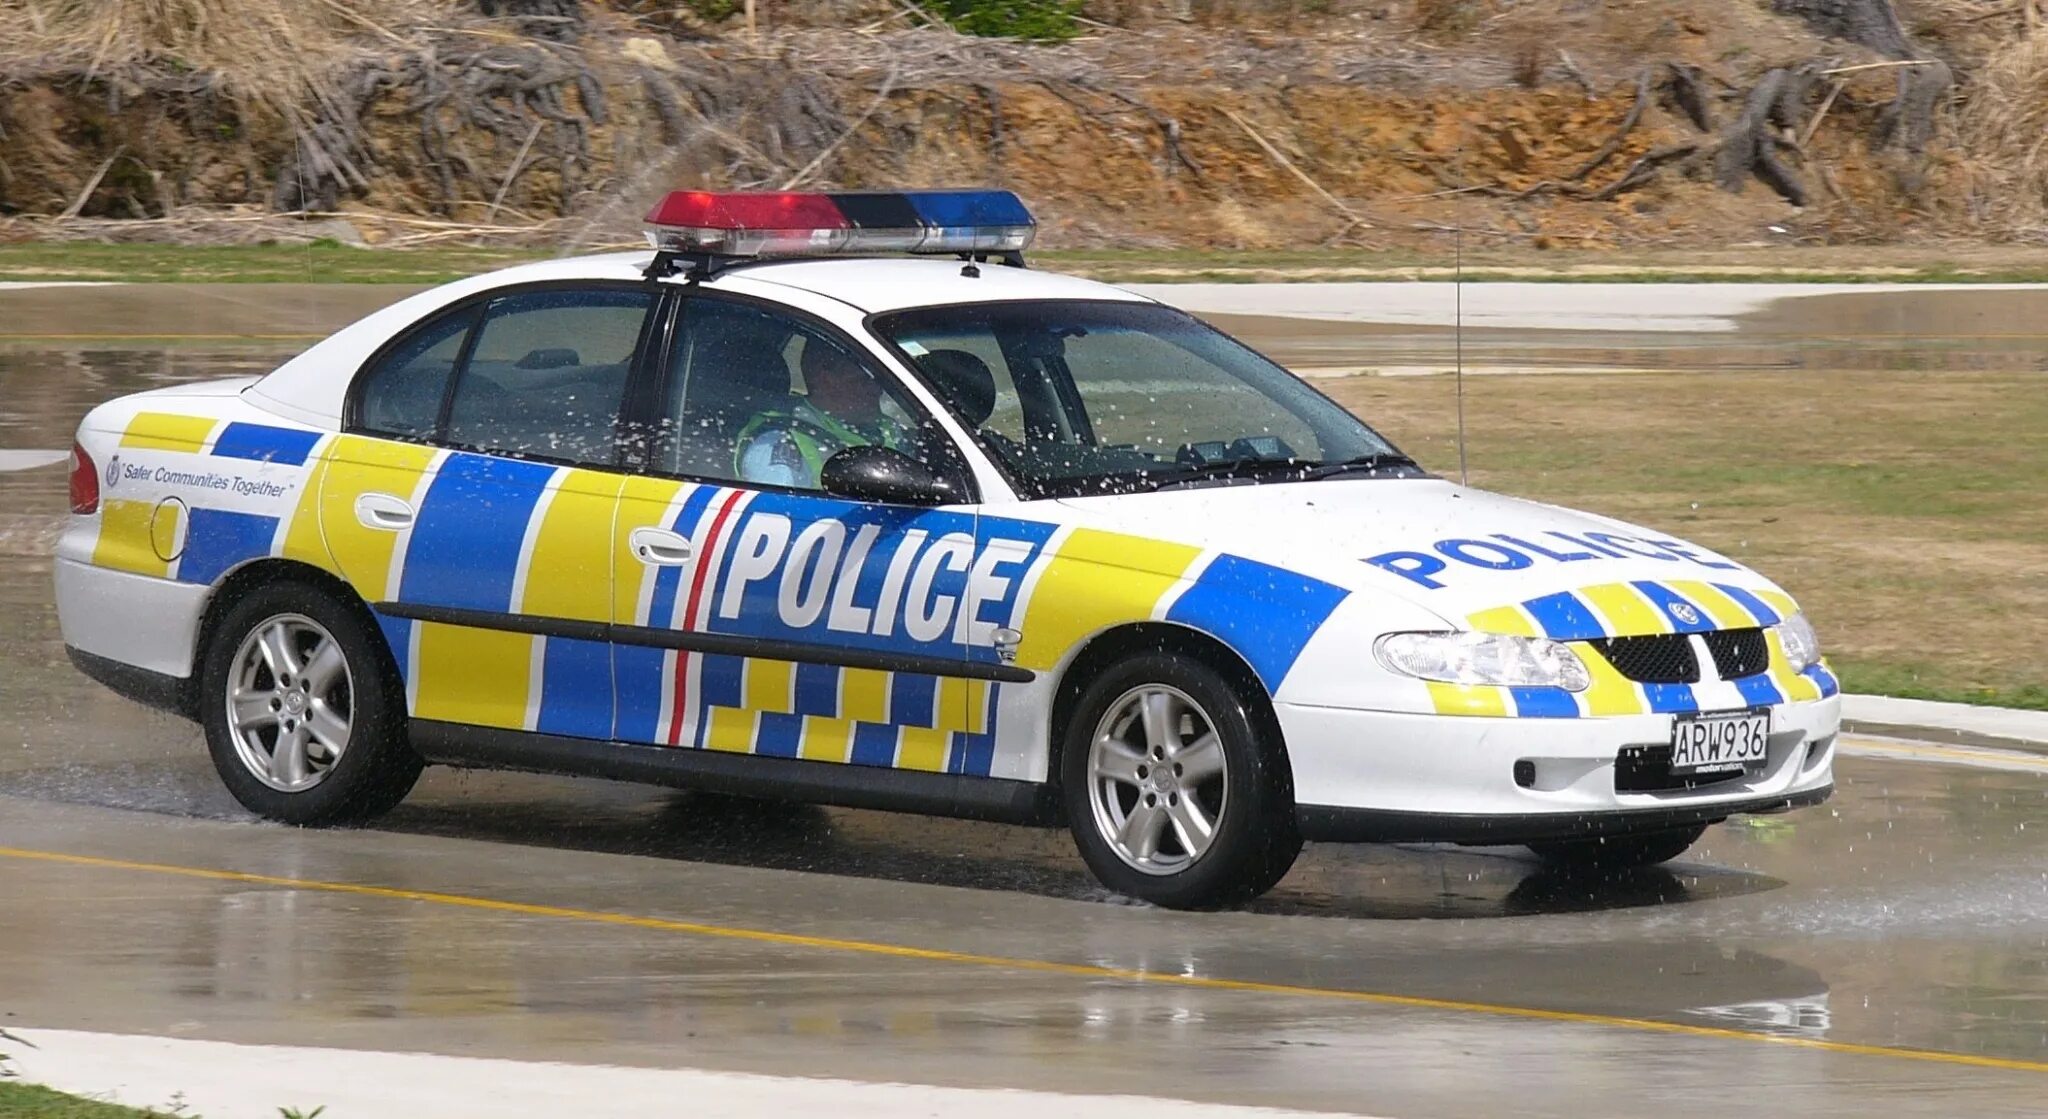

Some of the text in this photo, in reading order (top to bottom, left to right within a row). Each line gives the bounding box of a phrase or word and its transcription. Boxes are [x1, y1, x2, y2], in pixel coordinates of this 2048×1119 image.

[155, 467, 229, 489] Communities
[720, 511, 1034, 647] POLICE
[1359, 531, 1741, 590] POLICE
[1676, 720, 1763, 762] ARW936
